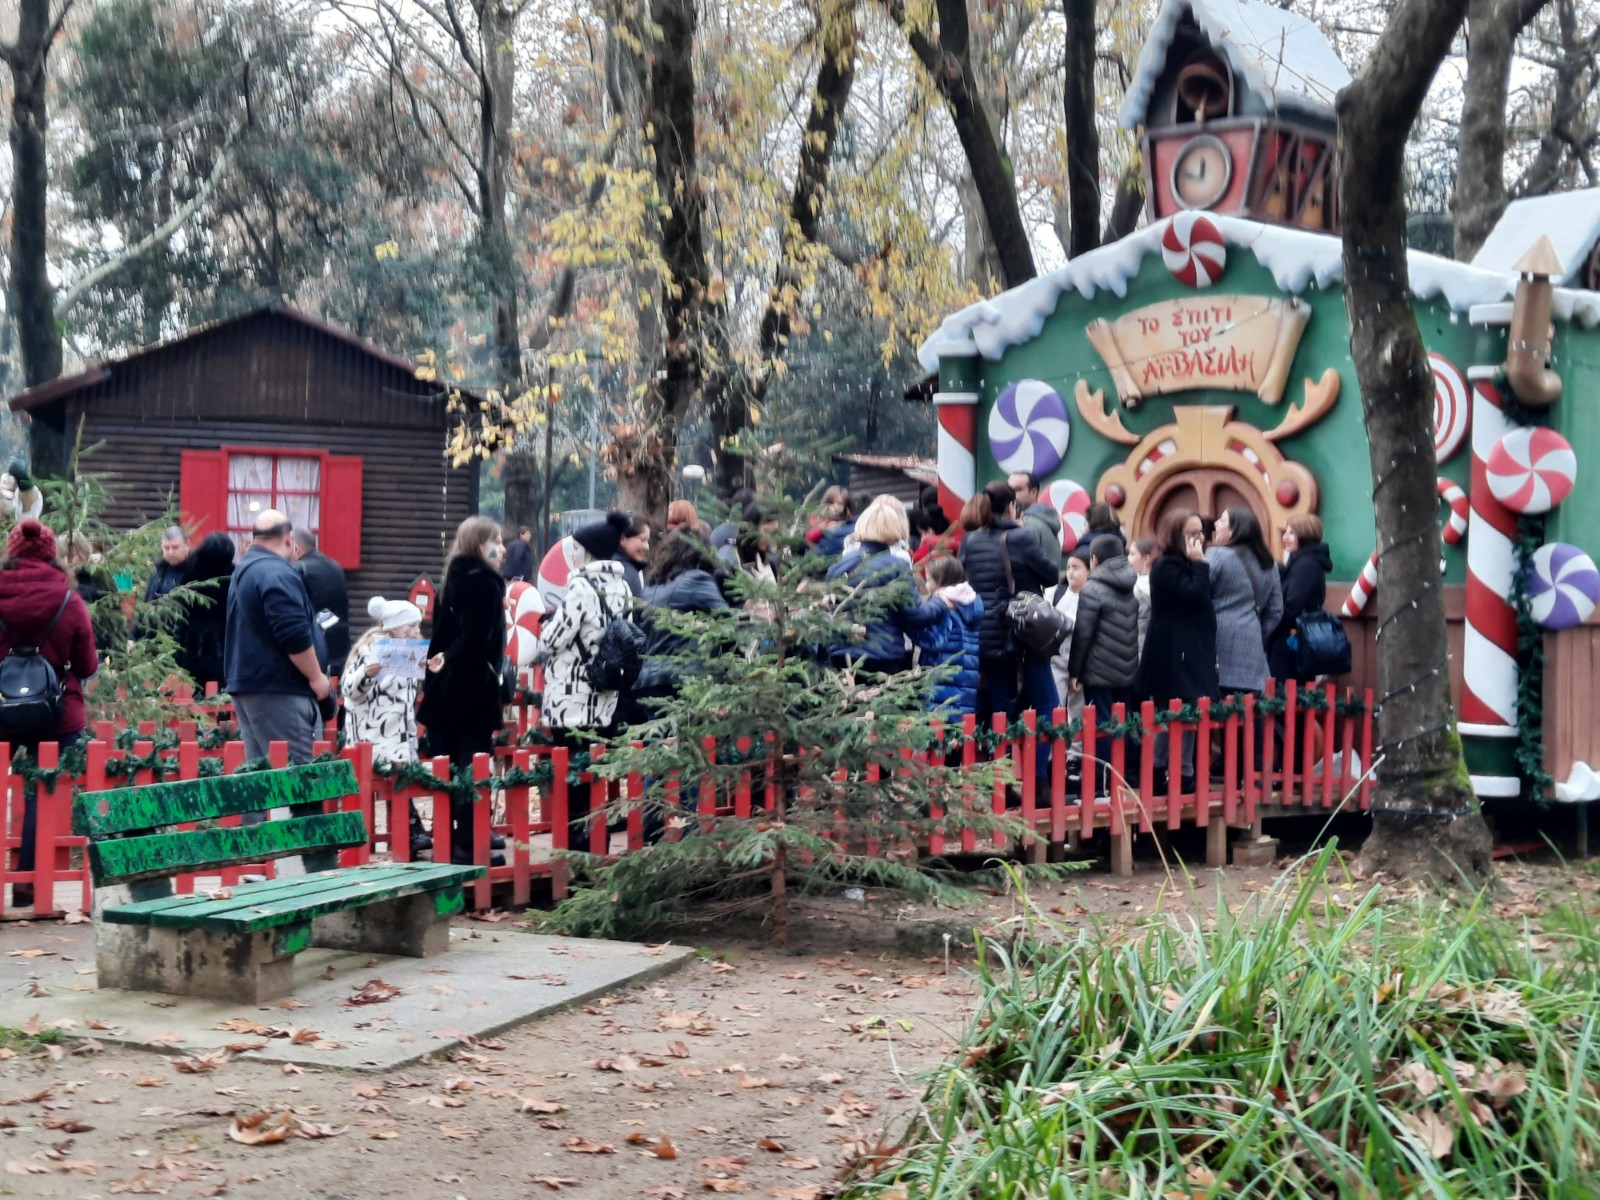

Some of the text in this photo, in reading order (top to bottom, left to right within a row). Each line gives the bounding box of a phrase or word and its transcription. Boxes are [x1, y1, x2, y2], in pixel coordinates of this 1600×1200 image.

[1138, 305, 1232, 335] ΤΟ ΣΠΙΤΙ
[1178, 326, 1212, 347] ΤΟΥ
